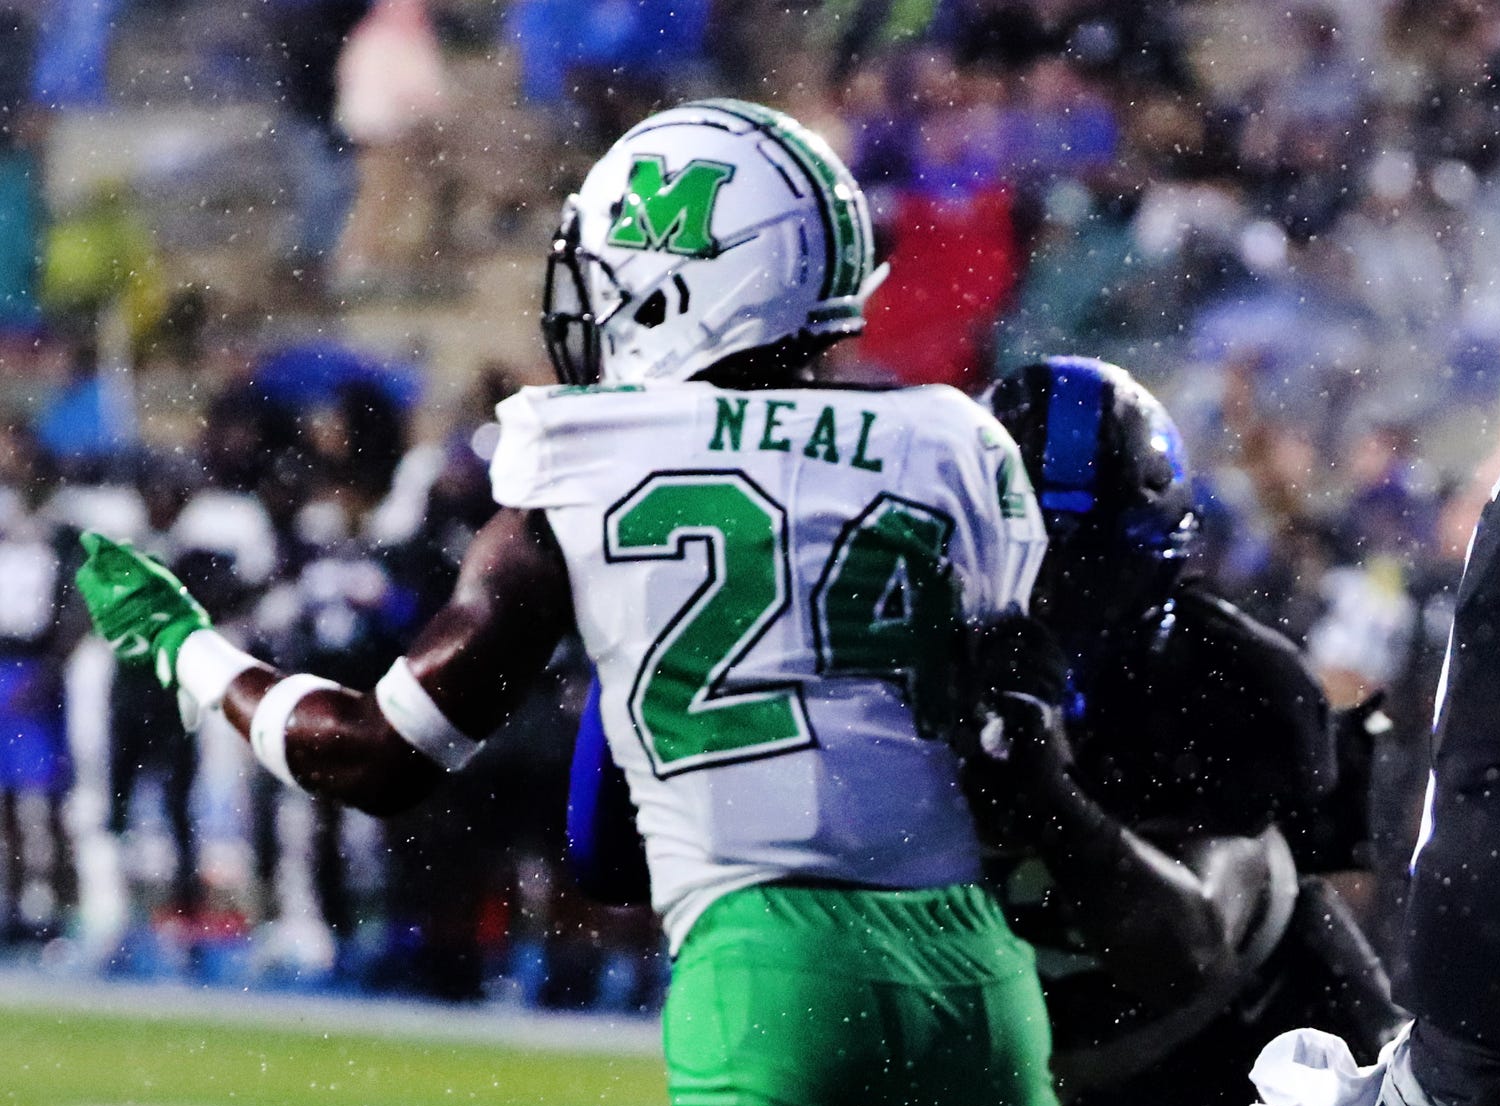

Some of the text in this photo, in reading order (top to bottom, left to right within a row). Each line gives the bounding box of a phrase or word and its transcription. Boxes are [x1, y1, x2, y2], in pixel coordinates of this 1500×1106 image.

[606, 153, 737, 259] M
[708, 397, 882, 473] NEAL
[604, 469, 958, 778] 24
